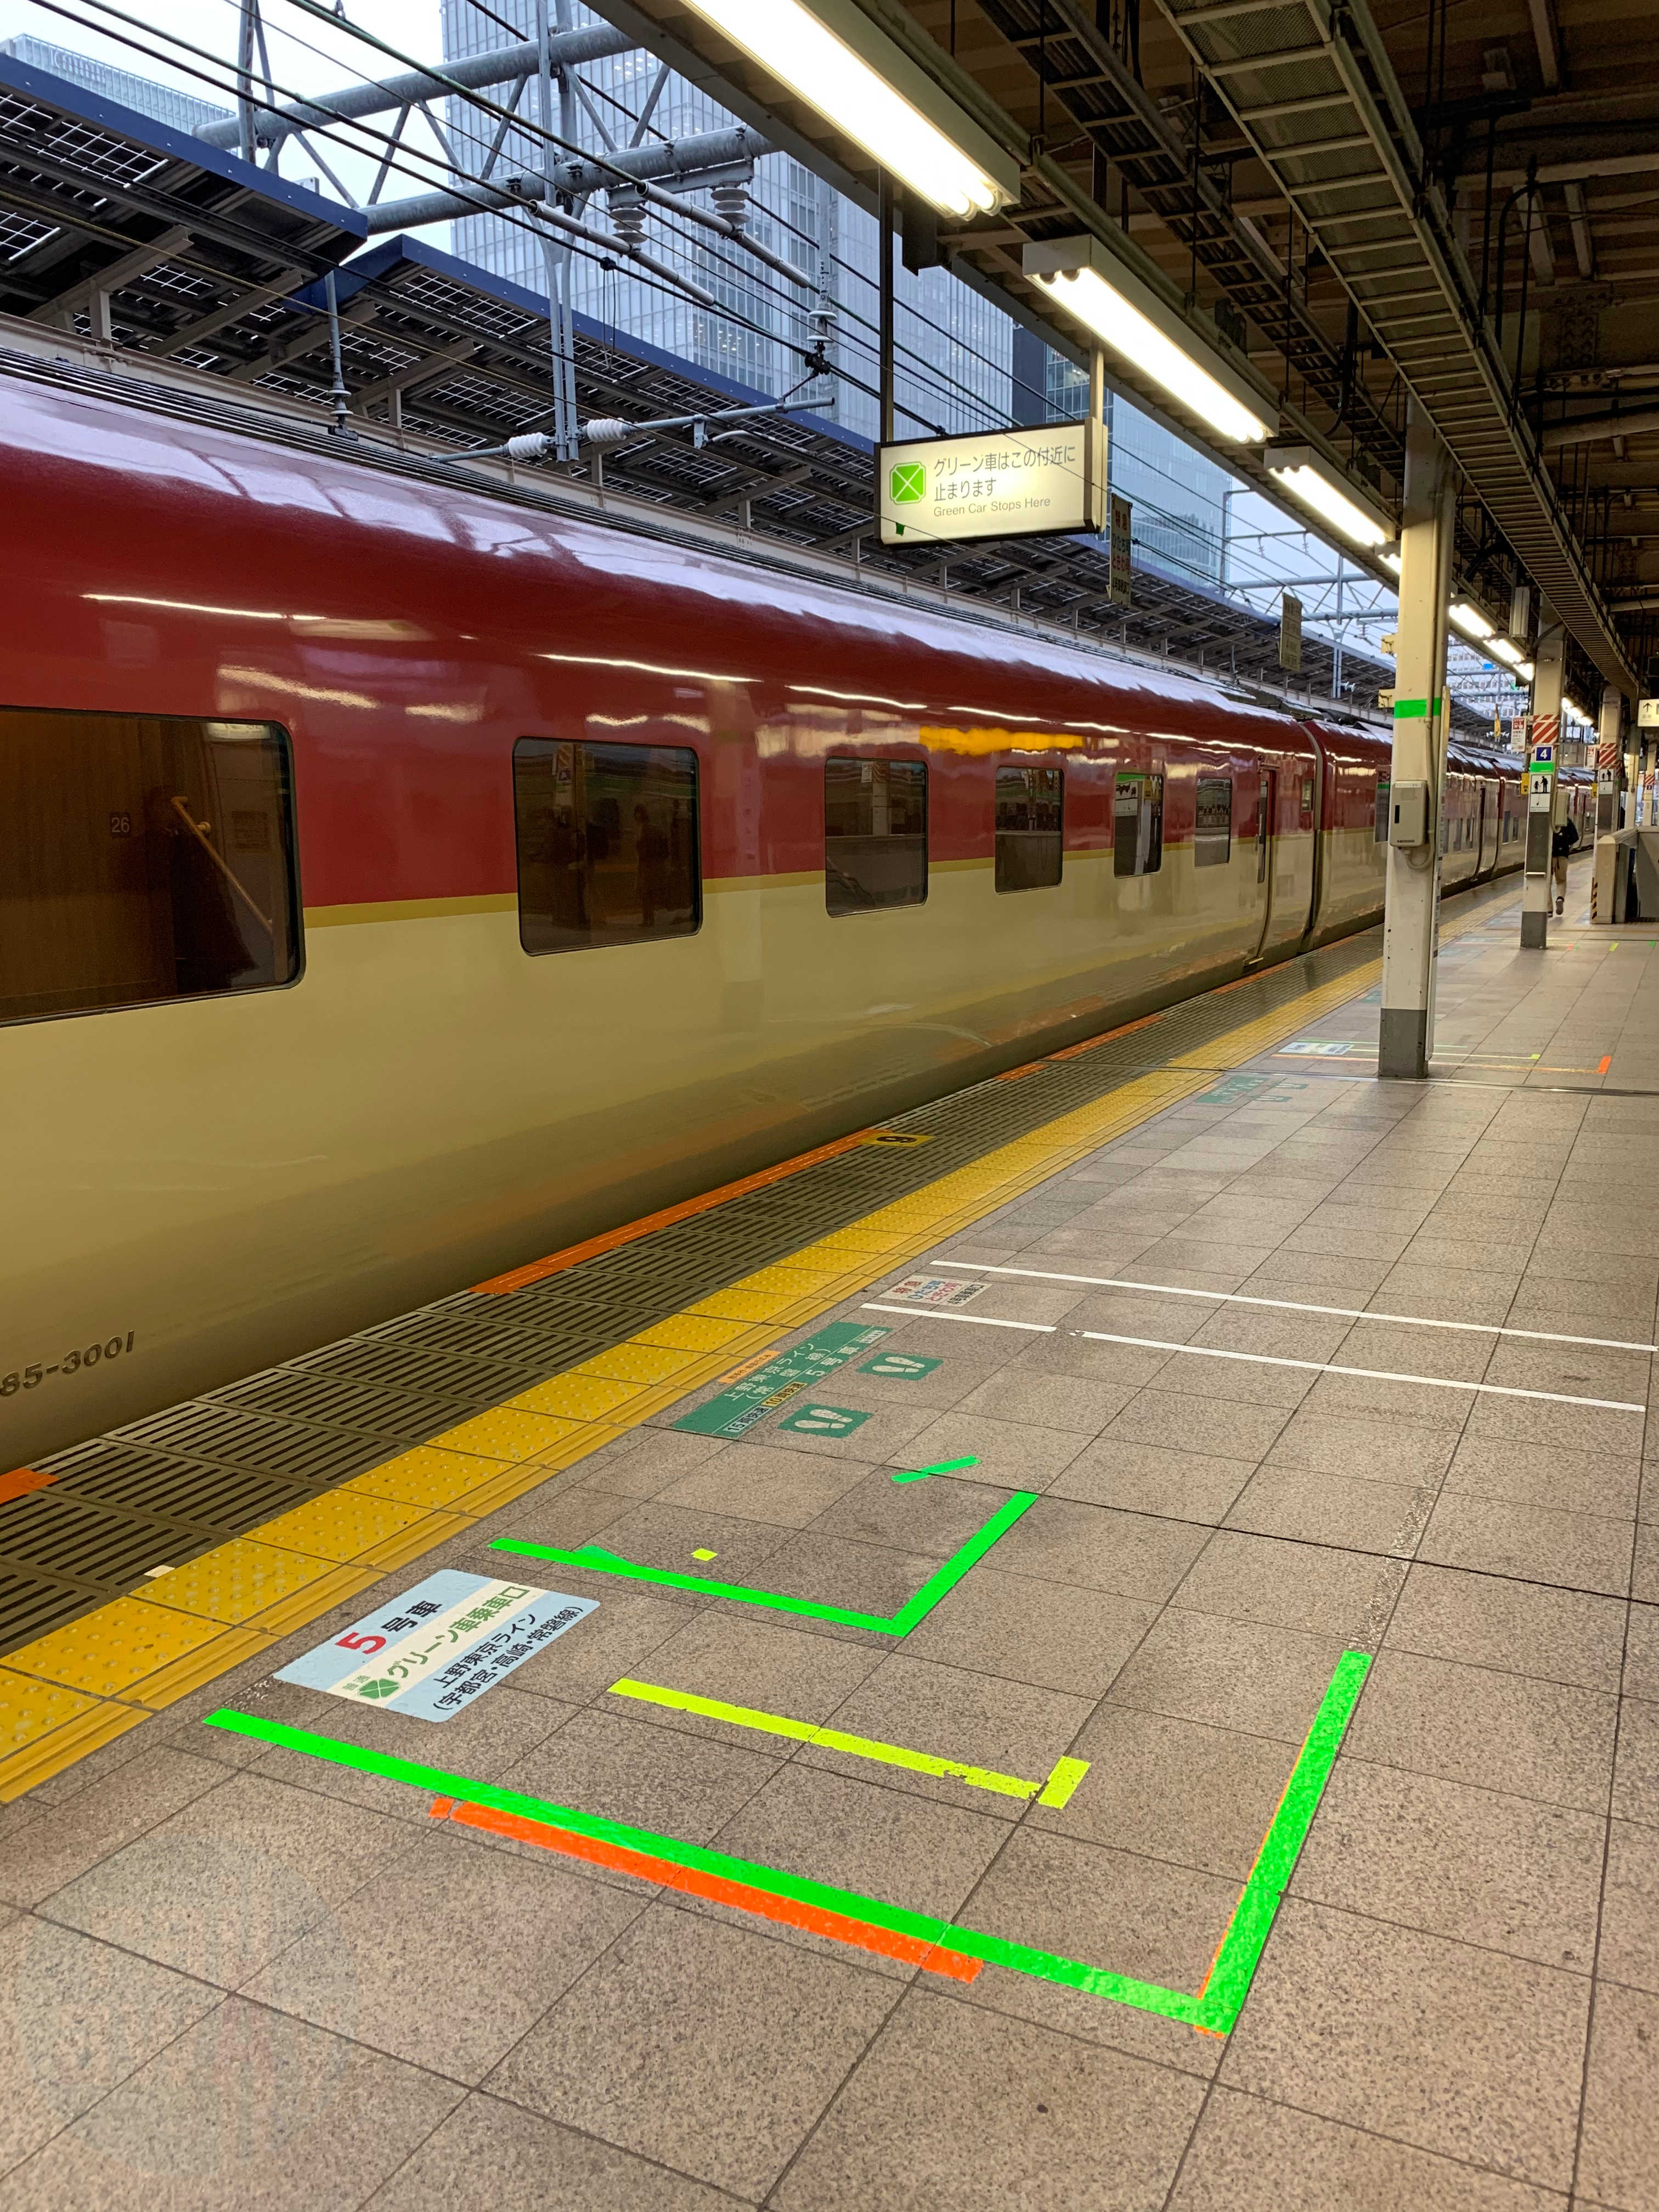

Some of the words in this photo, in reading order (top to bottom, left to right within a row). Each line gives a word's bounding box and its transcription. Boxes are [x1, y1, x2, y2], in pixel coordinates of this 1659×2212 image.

[934, 445, 1076, 478] グリーン車はこの付近に
[934, 477, 997, 502] 止まります
[934, 506, 965, 517] Green
[968, 503, 988, 514] Car
[991, 500, 1022, 512] Stops
[1025, 496, 1051, 508] Here
[1540, 749, 1548, 759] 4
[112, 817, 129, 832] 26
[893, 1281, 923, 1294] 特急
[907, 1280, 946, 1300] ひたち号
[926, 1282, 962, 1301] ときわ号
[724, 1343, 814, 1401] 上野東京ライン
[766, 1383, 805, 1405] 10両快速
[727, 1407, 769, 1431] 15両快速
[335, 1600, 443, 1655] 5号車
[387, 1585, 531, 1678] グリーン車乗車口
[433, 1613, 536, 1689] 上野東京ライン
[433, 1606, 584, 1711] (宇都宮・高崎・常磐線)
[342, 1675, 371, 1690] 普通
